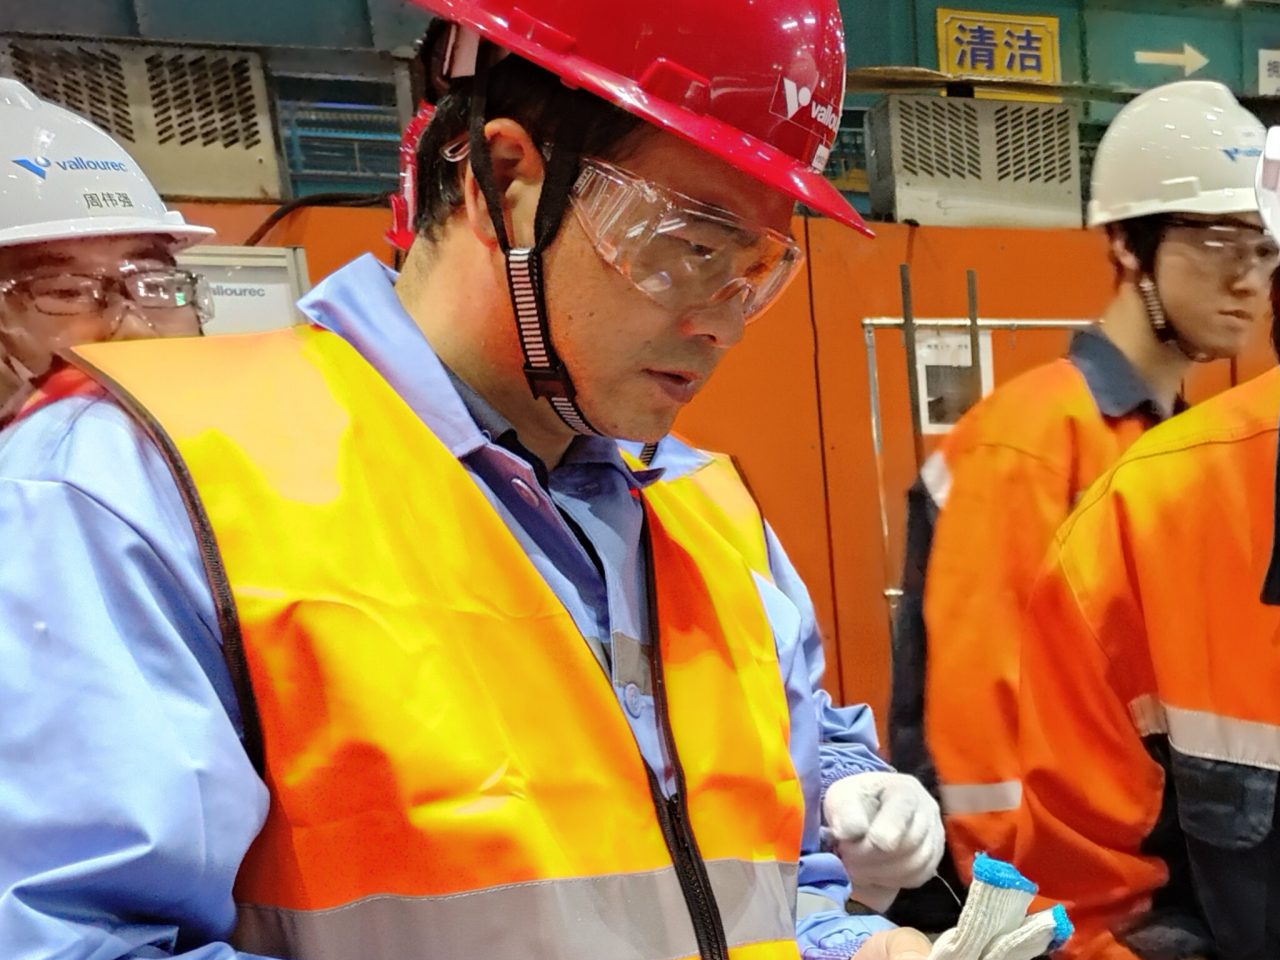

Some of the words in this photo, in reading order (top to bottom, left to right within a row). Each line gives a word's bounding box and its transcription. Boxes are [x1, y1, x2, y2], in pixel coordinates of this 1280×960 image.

[953, 24, 1042, 72] 清洁
[811, 101, 840, 133] vallo
[56, 157, 127, 172] vallourec
[83, 192, 133, 209] 周伟强
[210, 284, 265, 297] allourec
